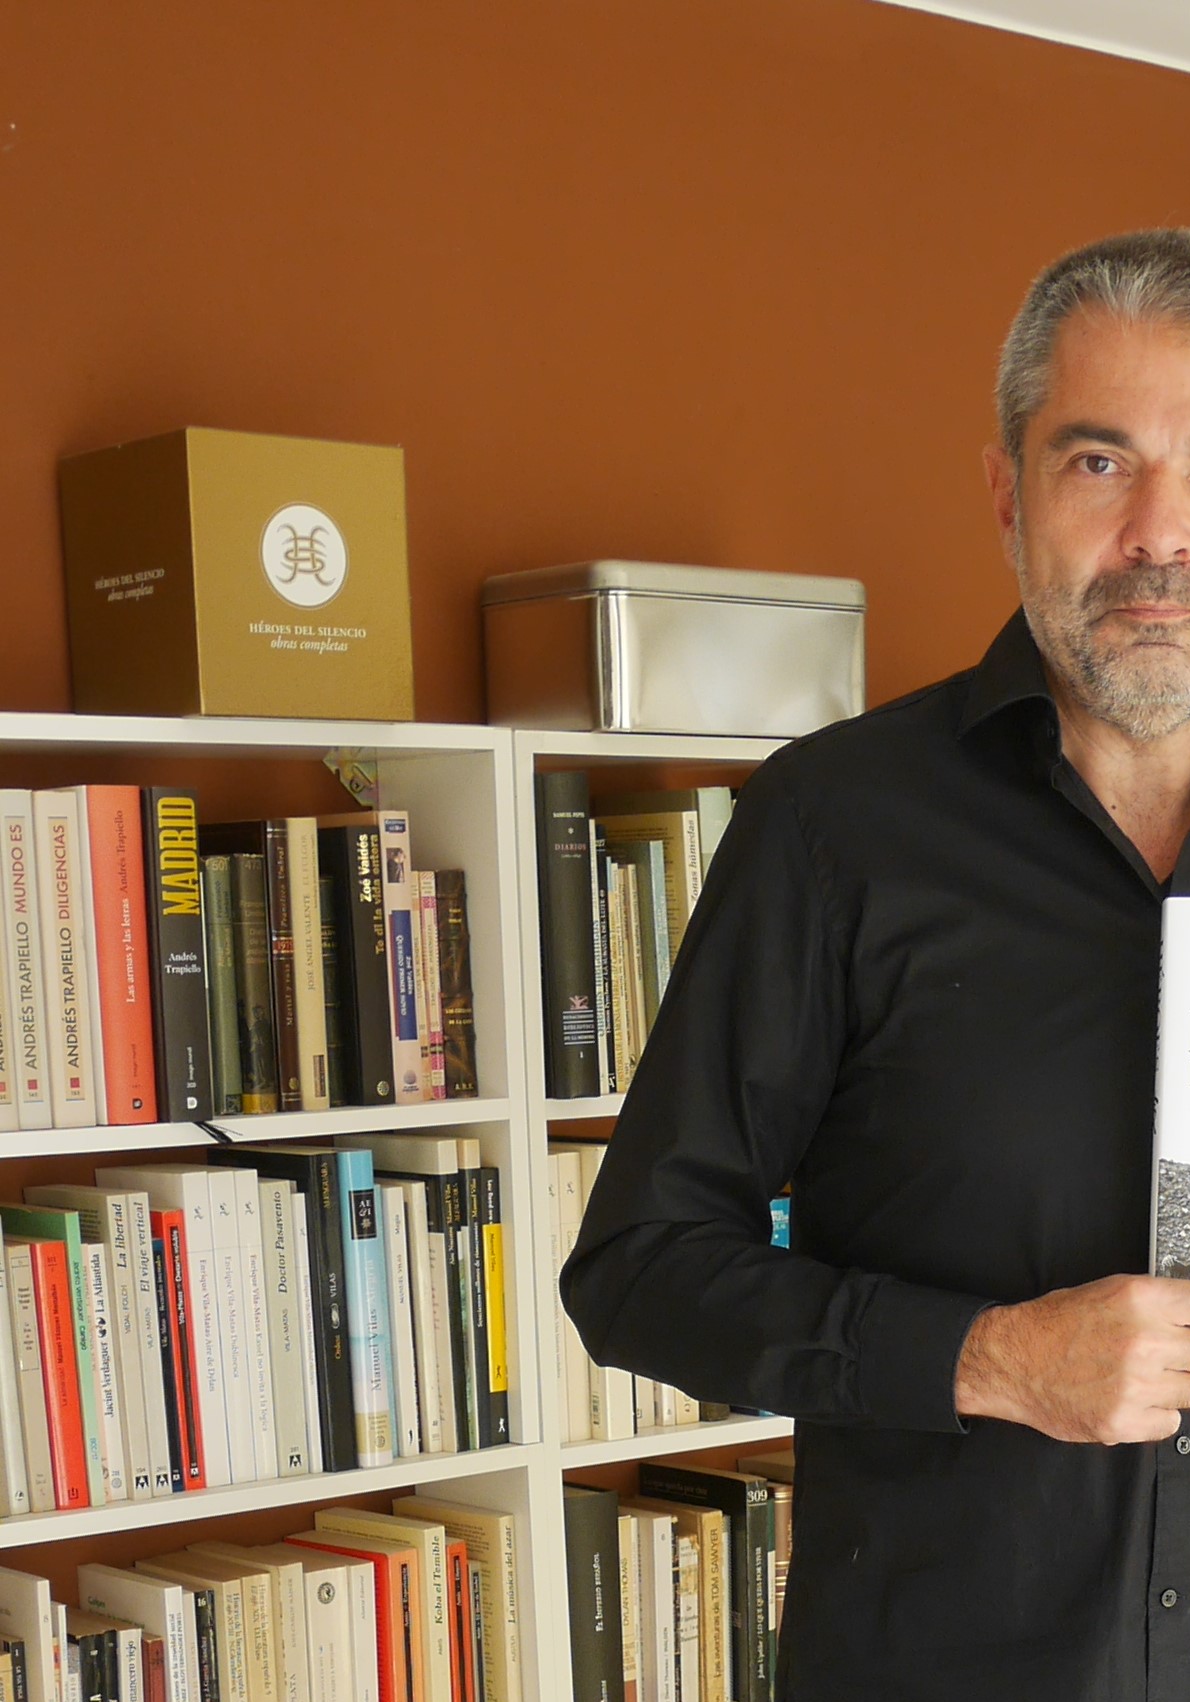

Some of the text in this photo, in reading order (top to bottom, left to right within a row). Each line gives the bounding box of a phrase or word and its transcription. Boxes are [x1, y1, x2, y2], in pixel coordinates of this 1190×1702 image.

[121, 573, 134, 586] DEL
[135, 568, 165, 582] SILENCIO
[249, 622, 366, 638] HÉROES DEL SILENCIO
[270, 638, 348, 655] obras completas
[157, 796, 200, 915] MADRID
[357, 834, 371, 902] Zoé Valdés
[369, 834, 384, 954] Te di la vida entera
[120, 898, 130, 926] letras
[10, 824, 38, 1070] ANDRÉS TRAPIELLO MUNDO ES
[53, 825, 79, 1068] ANDRÉS TRAPIELLO DILIGENCIAS
[121, 929, 132, 942] las
[124, 954, 134, 982] armas
[164, 965, 201, 974] Trapiello
[168, 954, 197, 963] Andrés
[124, 985, 135, 1002] Las
[112, 1204, 127, 1269] La libertad
[134, 1202, 151, 1292] El viaje vertical
[273, 1191, 288, 1293] Doctor Pasavento
[91, 1254, 104, 1296] Atlántida
[95, 1299, 105, 1313] La
[367, 1308, 382, 1391] Manuel Vilas
[102, 1390, 114, 1418] Jacint
[709, 1528, 720, 1573] SAWYER
[430, 1535, 444, 1624] Koba el Temible
[503, 1526, 517, 1624] La música del azar
[710, 1576, 720, 1600] TOM
[711, 1602, 720, 1613] de
[125, 1640, 137, 1662] viejo
